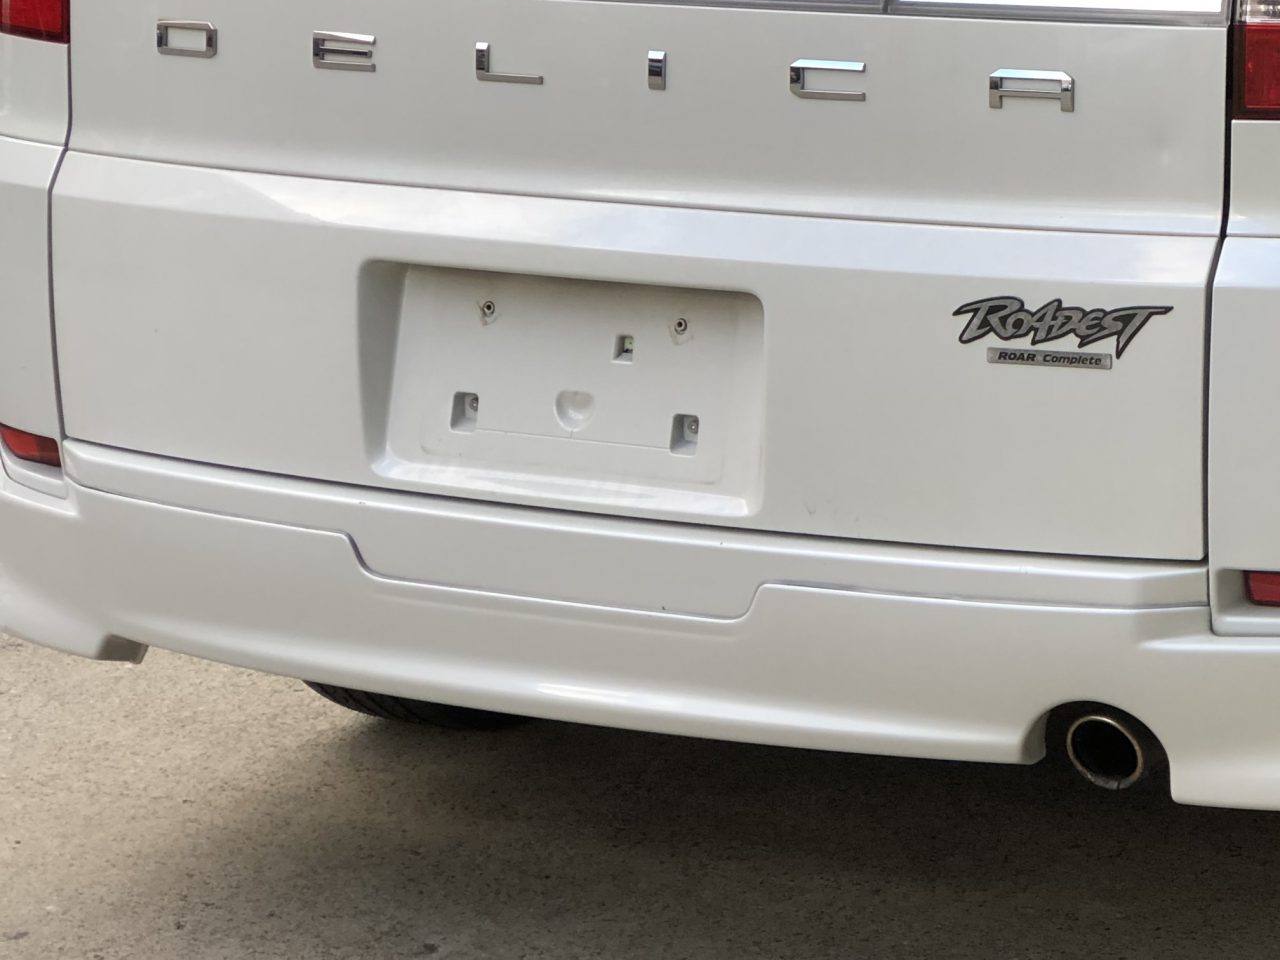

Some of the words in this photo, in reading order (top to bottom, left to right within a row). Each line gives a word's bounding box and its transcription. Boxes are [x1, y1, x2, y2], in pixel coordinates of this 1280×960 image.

[157, 20, 1075, 112] DELICA
[998, 351, 1036, 362] ROAR
[1042, 353, 1102, 366] Complete
